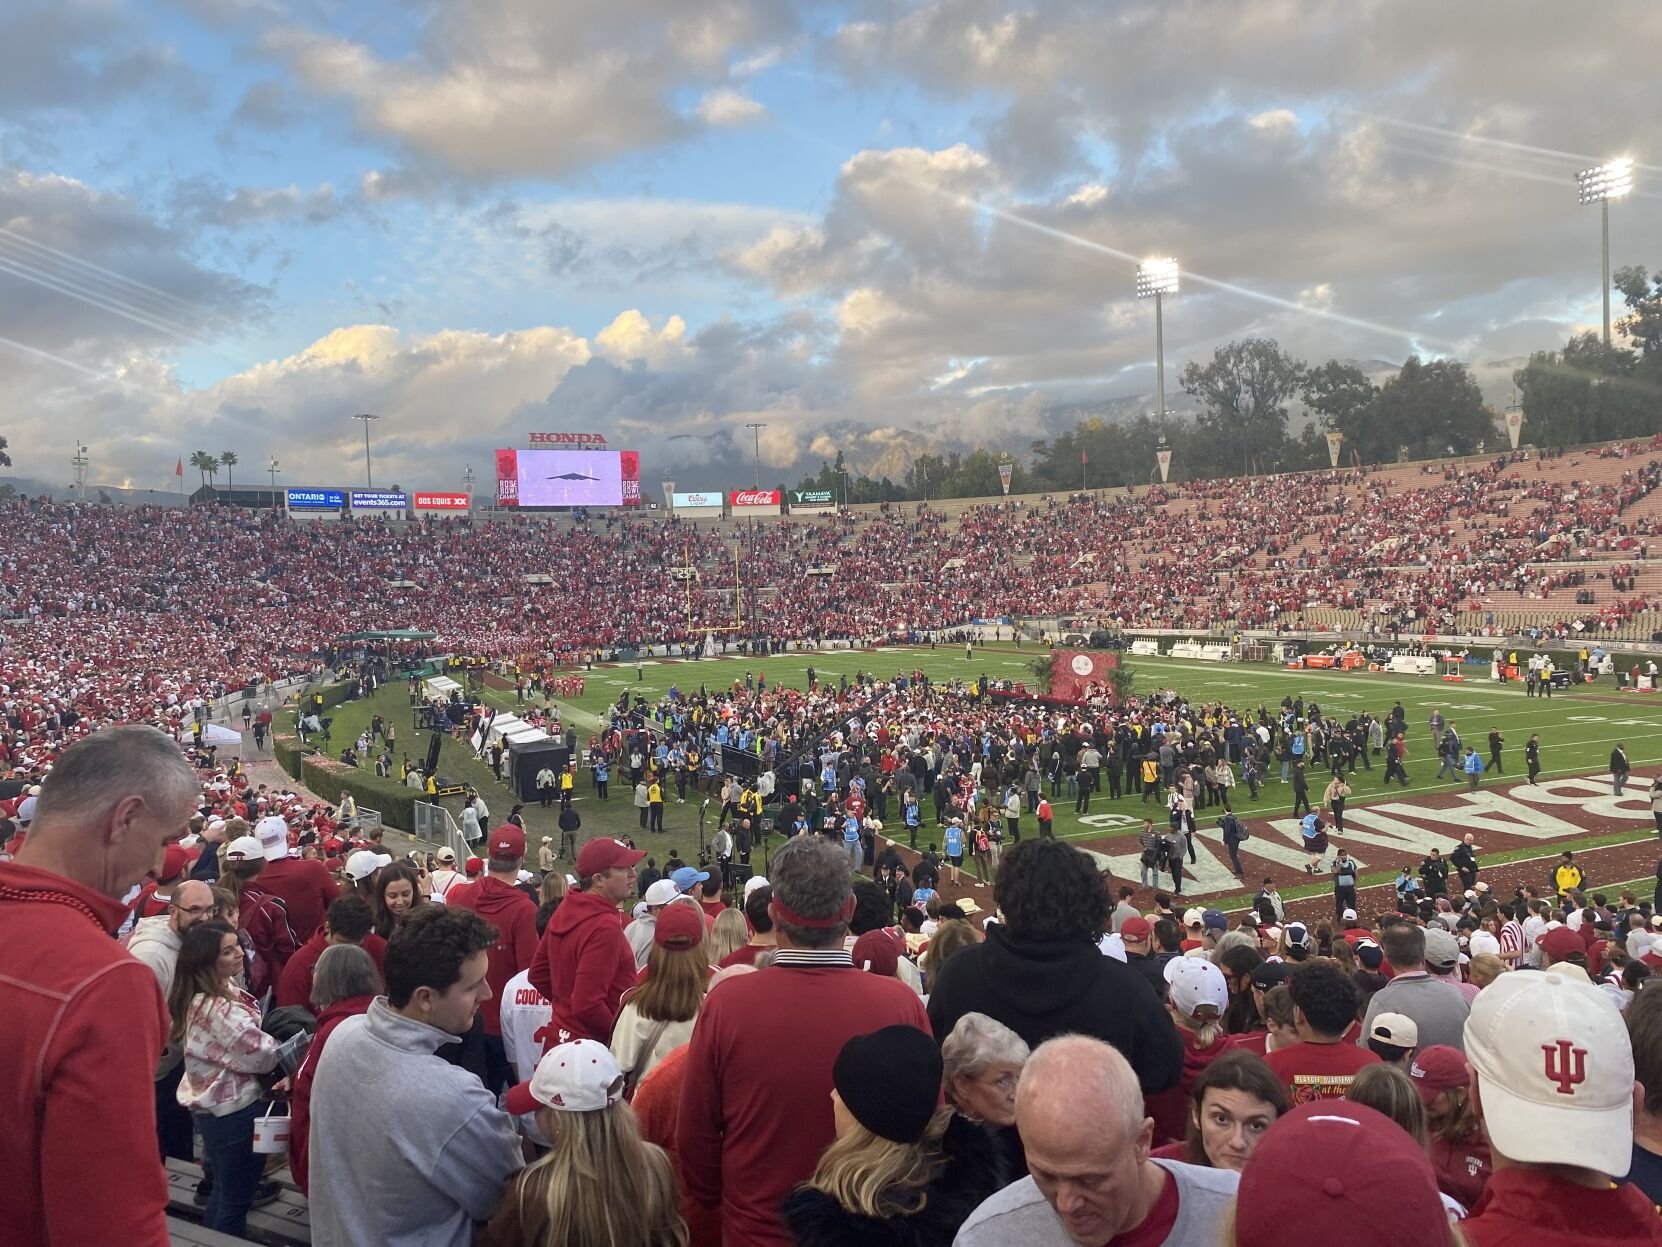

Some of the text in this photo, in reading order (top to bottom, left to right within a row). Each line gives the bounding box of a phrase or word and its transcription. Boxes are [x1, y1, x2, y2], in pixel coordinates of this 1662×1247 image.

[528, 432, 608, 443] HONDA
[418, 497, 431, 505] DOS
[432, 497, 451, 505] EQUIS
[736, 490, 774, 505] Coca-Cola
[1541, 1040, 1587, 1095] IU
[1295, 1075, 1320, 1083] PLAYOFF
[1321, 1084, 1347, 1094] at the
